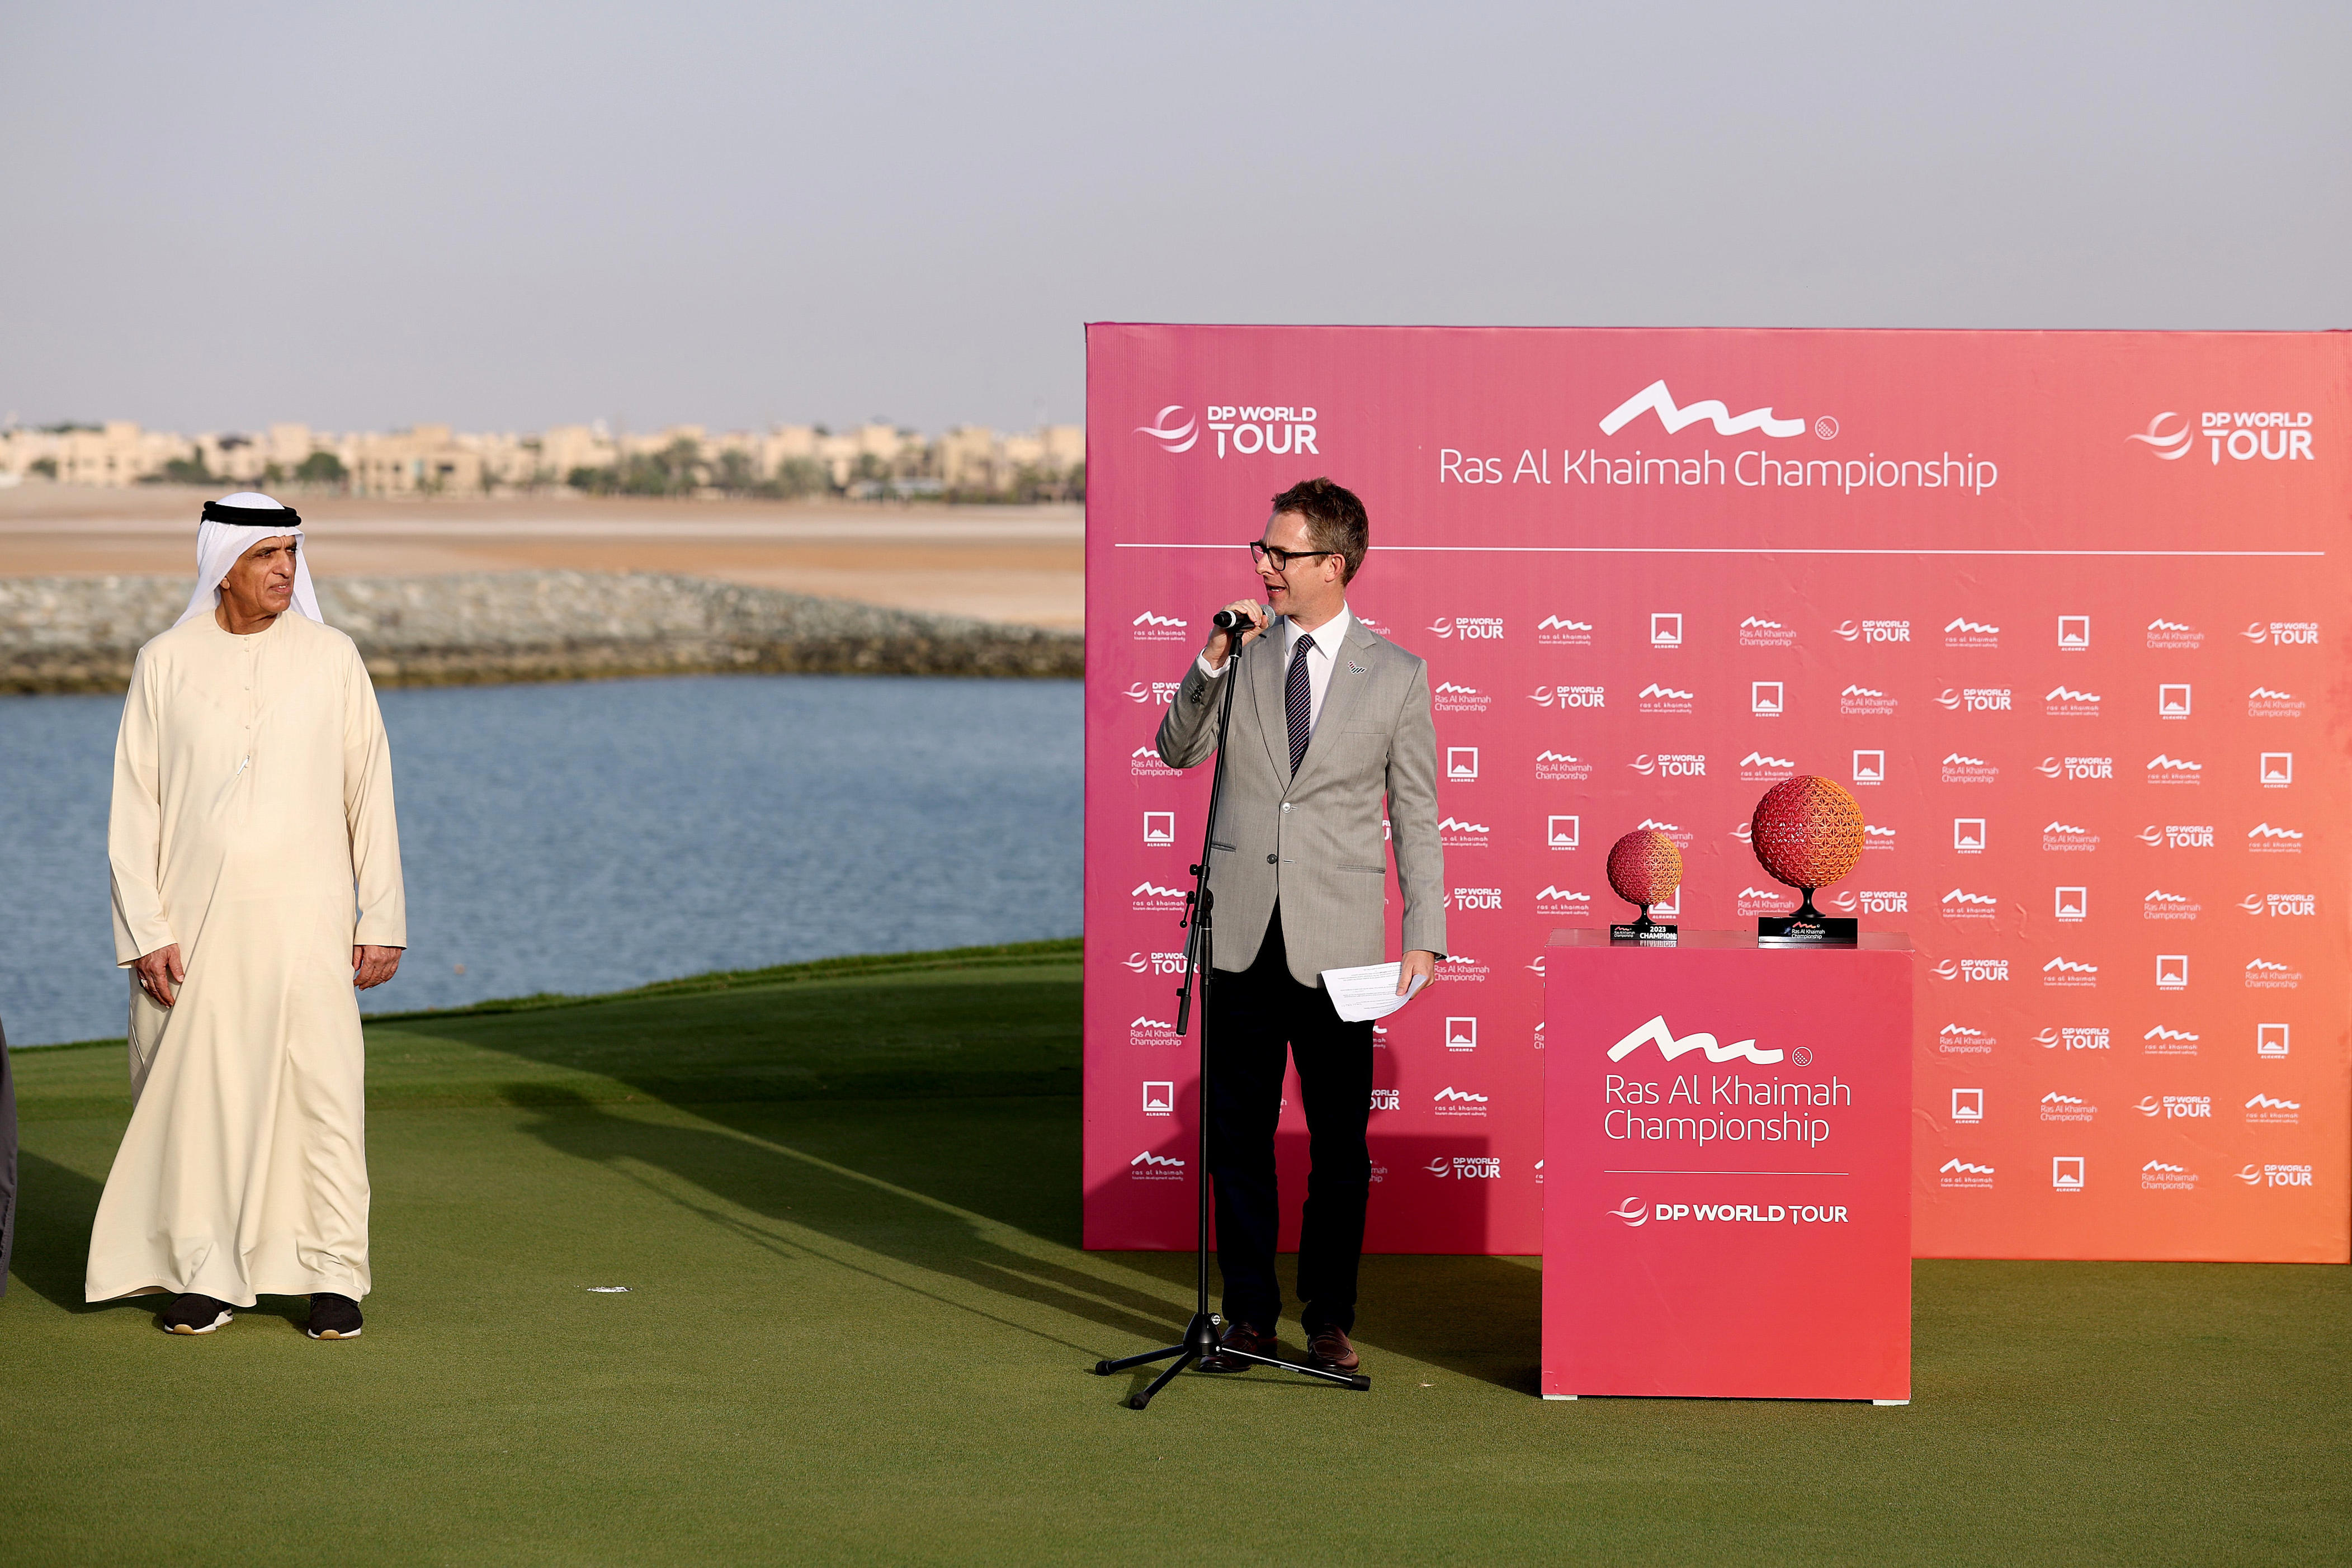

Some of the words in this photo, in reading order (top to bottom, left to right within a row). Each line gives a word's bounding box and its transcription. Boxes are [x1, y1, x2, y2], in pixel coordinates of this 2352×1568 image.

[1208, 406, 1237, 421] DP
[1239, 407, 1317, 422] WORLD
[2202, 412, 2232, 427] DP
[2233, 412, 2312, 427] WORLD
[1208, 423, 1320, 459] TOUR
[2202, 429, 2315, 466] TOUR
[1441, 448, 1503, 484] Ras
[1513, 448, 1551, 484] Al
[1564, 448, 1725, 485] Khaimah
[1735, 450, 1997, 496] Championship
[1456, 625, 1504, 641] TOUR
[1863, 627, 1910, 644] TOUR
[2270, 630, 2318, 646] TOUR
[1739, 637, 1792, 646] Championship
[2147, 640, 2199, 649] Championship
[1435, 703, 1487, 712] Championship
[1557, 693, 1605, 709] TOUR
[1964, 696, 2012, 712] TOUR
[1841, 706, 1893, 715] Championship
[1536, 772, 1588, 781] Championship
[1658, 762, 1706, 778] TOUR
[2065, 765, 2113, 781] TOUR
[1942, 774, 1994, 783] Championship
[2043, 843, 2095, 852] Championship
[2166, 833, 2213, 849] TOUR
[1454, 895, 1502, 911] TOUR
[1860, 898, 1908, 914] TOUR
[2267, 901, 2315, 918] TOUR
[1961, 966, 2009, 983] TOUR
[2245, 980, 2297, 989] Championship
[1939, 1045, 1991, 1054] Championship
[2062, 1035, 2110, 1051] TOUR
[1606, 1074, 1660, 1104] Ras
[1668, 1074, 1701, 1105] Al
[1712, 1075, 1850, 1106] Khaimah
[2163, 1104, 2211, 1120] TOUR
[1604, 1109, 1830, 1148] Championship
[1453, 1164, 1501, 1180] TOUR
[2265, 1172, 2313, 1188] TOUR
[2142, 1181, 2194, 1190] Championship
[1656, 1204, 1689, 1221] DP
[1692, 1204, 1786, 1222] WORLD
[1788, 1205, 1849, 1225] TOUR
